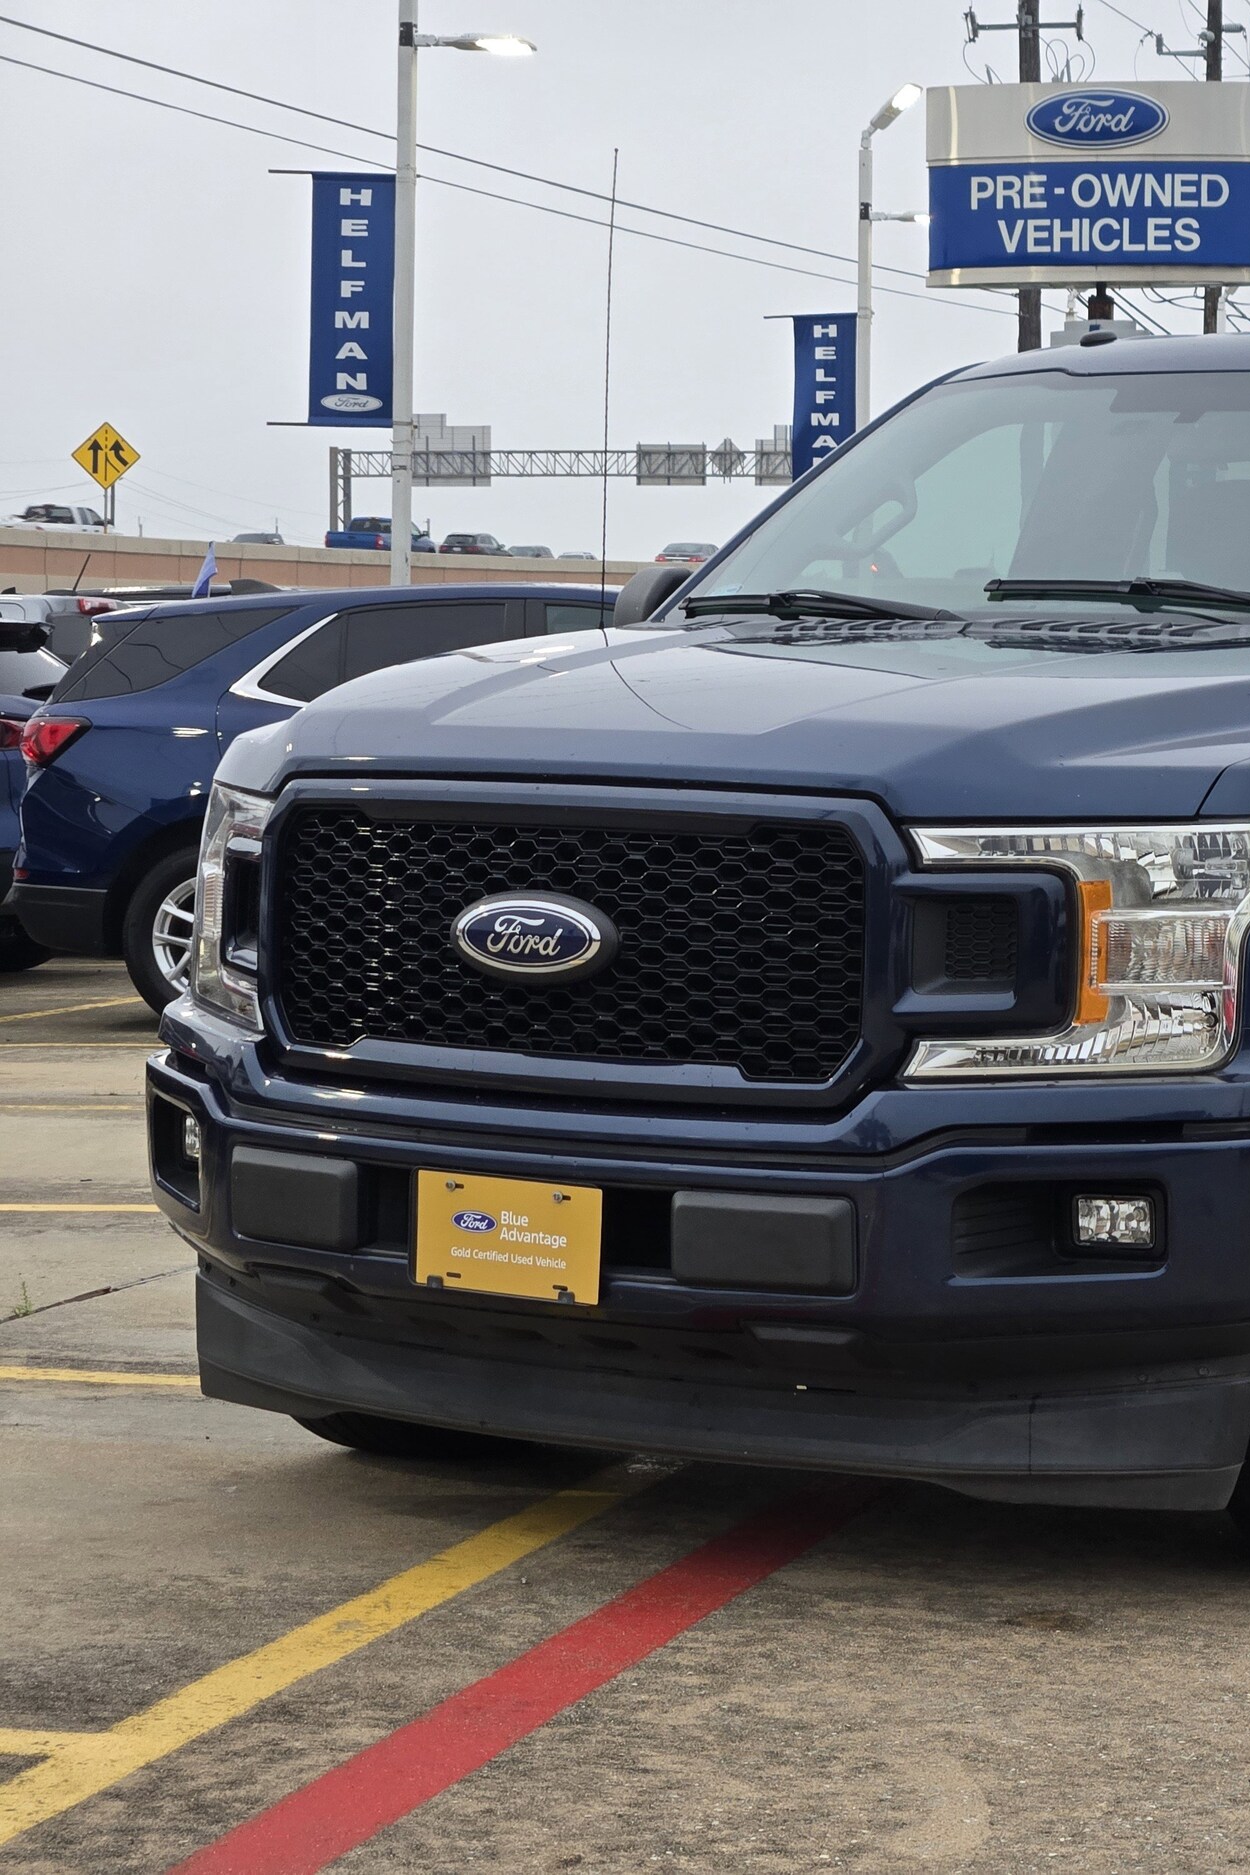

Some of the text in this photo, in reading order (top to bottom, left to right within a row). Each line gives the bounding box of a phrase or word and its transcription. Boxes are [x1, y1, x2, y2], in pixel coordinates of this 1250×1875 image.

[1053, 98, 1136, 133] Ford
[998, 217, 1201, 253] VEHICLES
[334, 188, 373, 391] HELFMAN
[334, 396, 369, 409] Ford
[486, 914, 564, 957] Ford
[460, 1213, 489, 1231] Ford
[500, 1210, 530, 1227] Blue
[499, 1227, 568, 1249] Advantage
[450, 1246, 567, 1270] Gold Certified Used Vehicle
